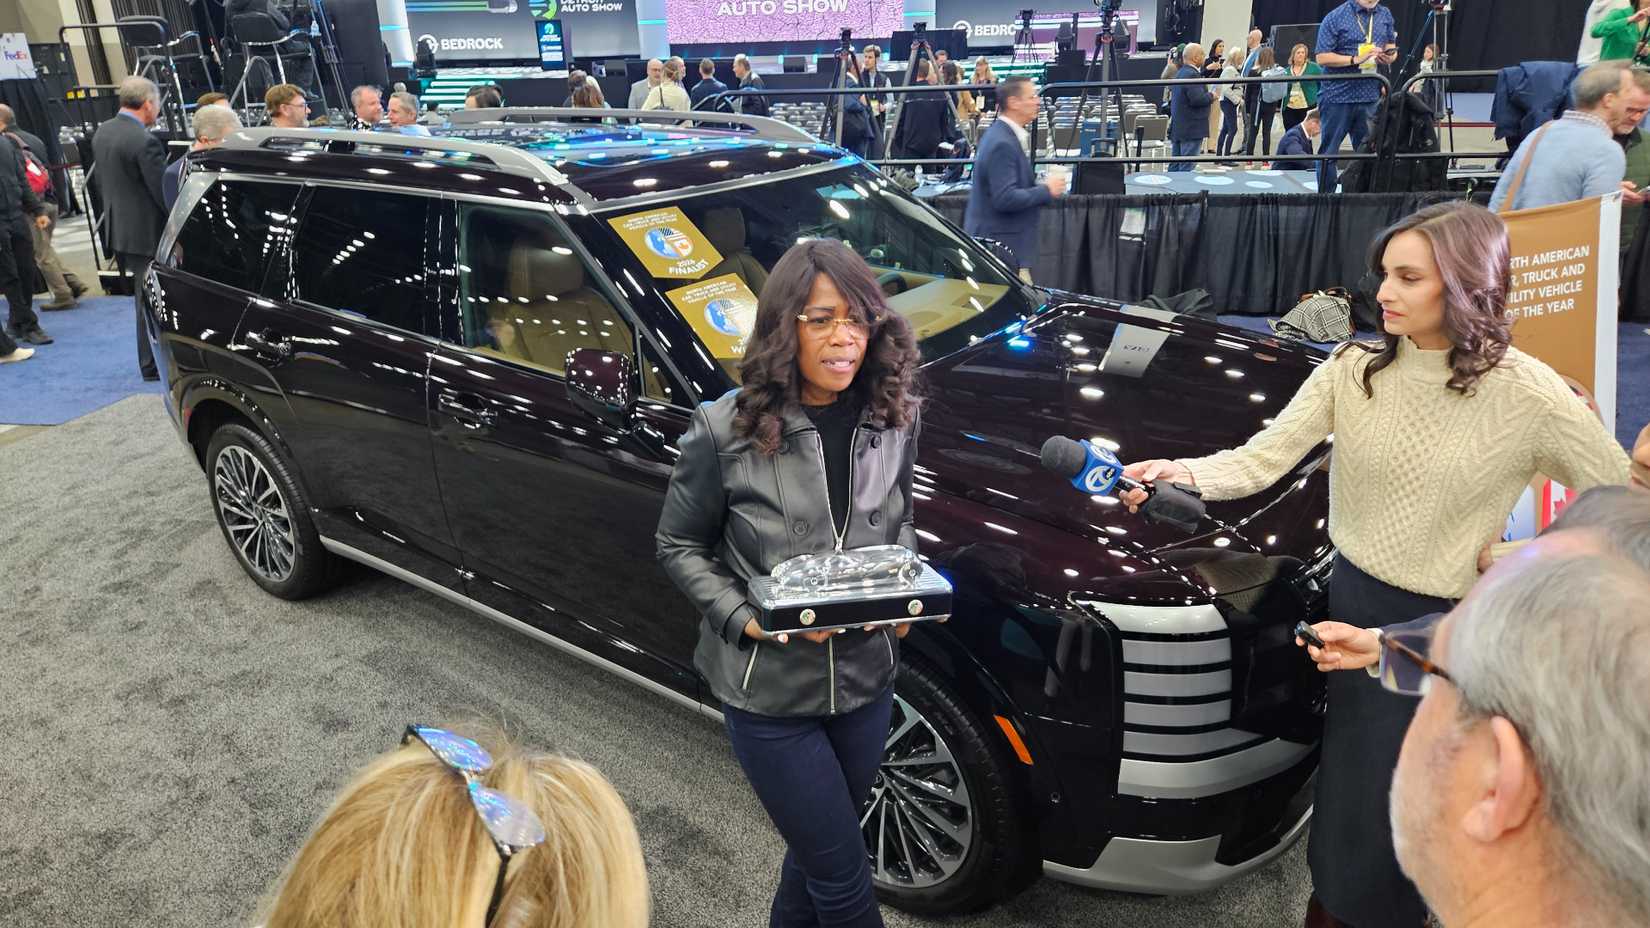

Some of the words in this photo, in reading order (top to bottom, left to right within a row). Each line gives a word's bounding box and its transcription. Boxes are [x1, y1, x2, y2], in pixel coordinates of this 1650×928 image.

[561, 4, 590, 13] AUTO
[591, 2, 623, 12] SHOW
[716, 1, 777, 16] AUTO
[783, 0, 849, 15] SHOW
[974, 24, 1016, 36] BEDRO
[440, 38, 504, 50] BEDROCK
[1509, 255, 1529, 269] RTH
[1531, 245, 1590, 266] AMERICAN
[668, 259, 709, 275] FINALIST
[1521, 267, 1559, 284] TRUCK
[1560, 263, 1586, 278] AND
[1508, 287, 1537, 304] ILITY
[1538, 280, 1583, 298] VEHICLE
[1504, 307, 1521, 320] OF
[1522, 303, 1545, 318] THE
[1546, 298, 1574, 313] YEAR
